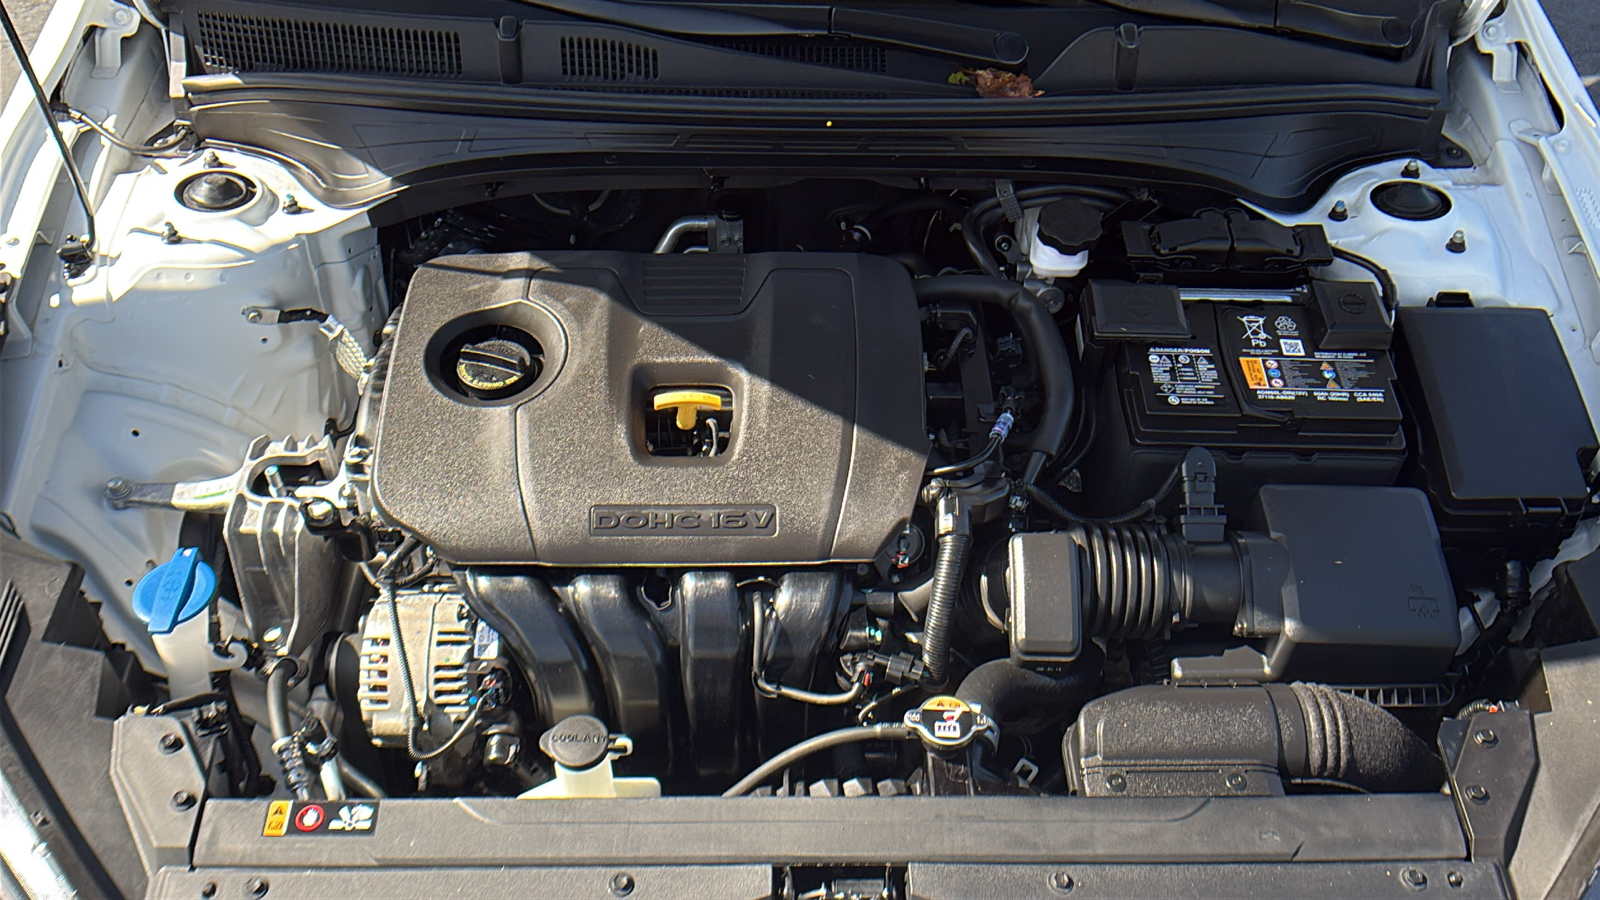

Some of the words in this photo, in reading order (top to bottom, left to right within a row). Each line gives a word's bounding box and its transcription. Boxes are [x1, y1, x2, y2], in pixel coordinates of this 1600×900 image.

[1251, 338, 1267, 348] Pb
[593, 511, 702, 530] DOHC
[711, 511, 774, 530] 16V
[551, 733, 607, 743] COOLANT
